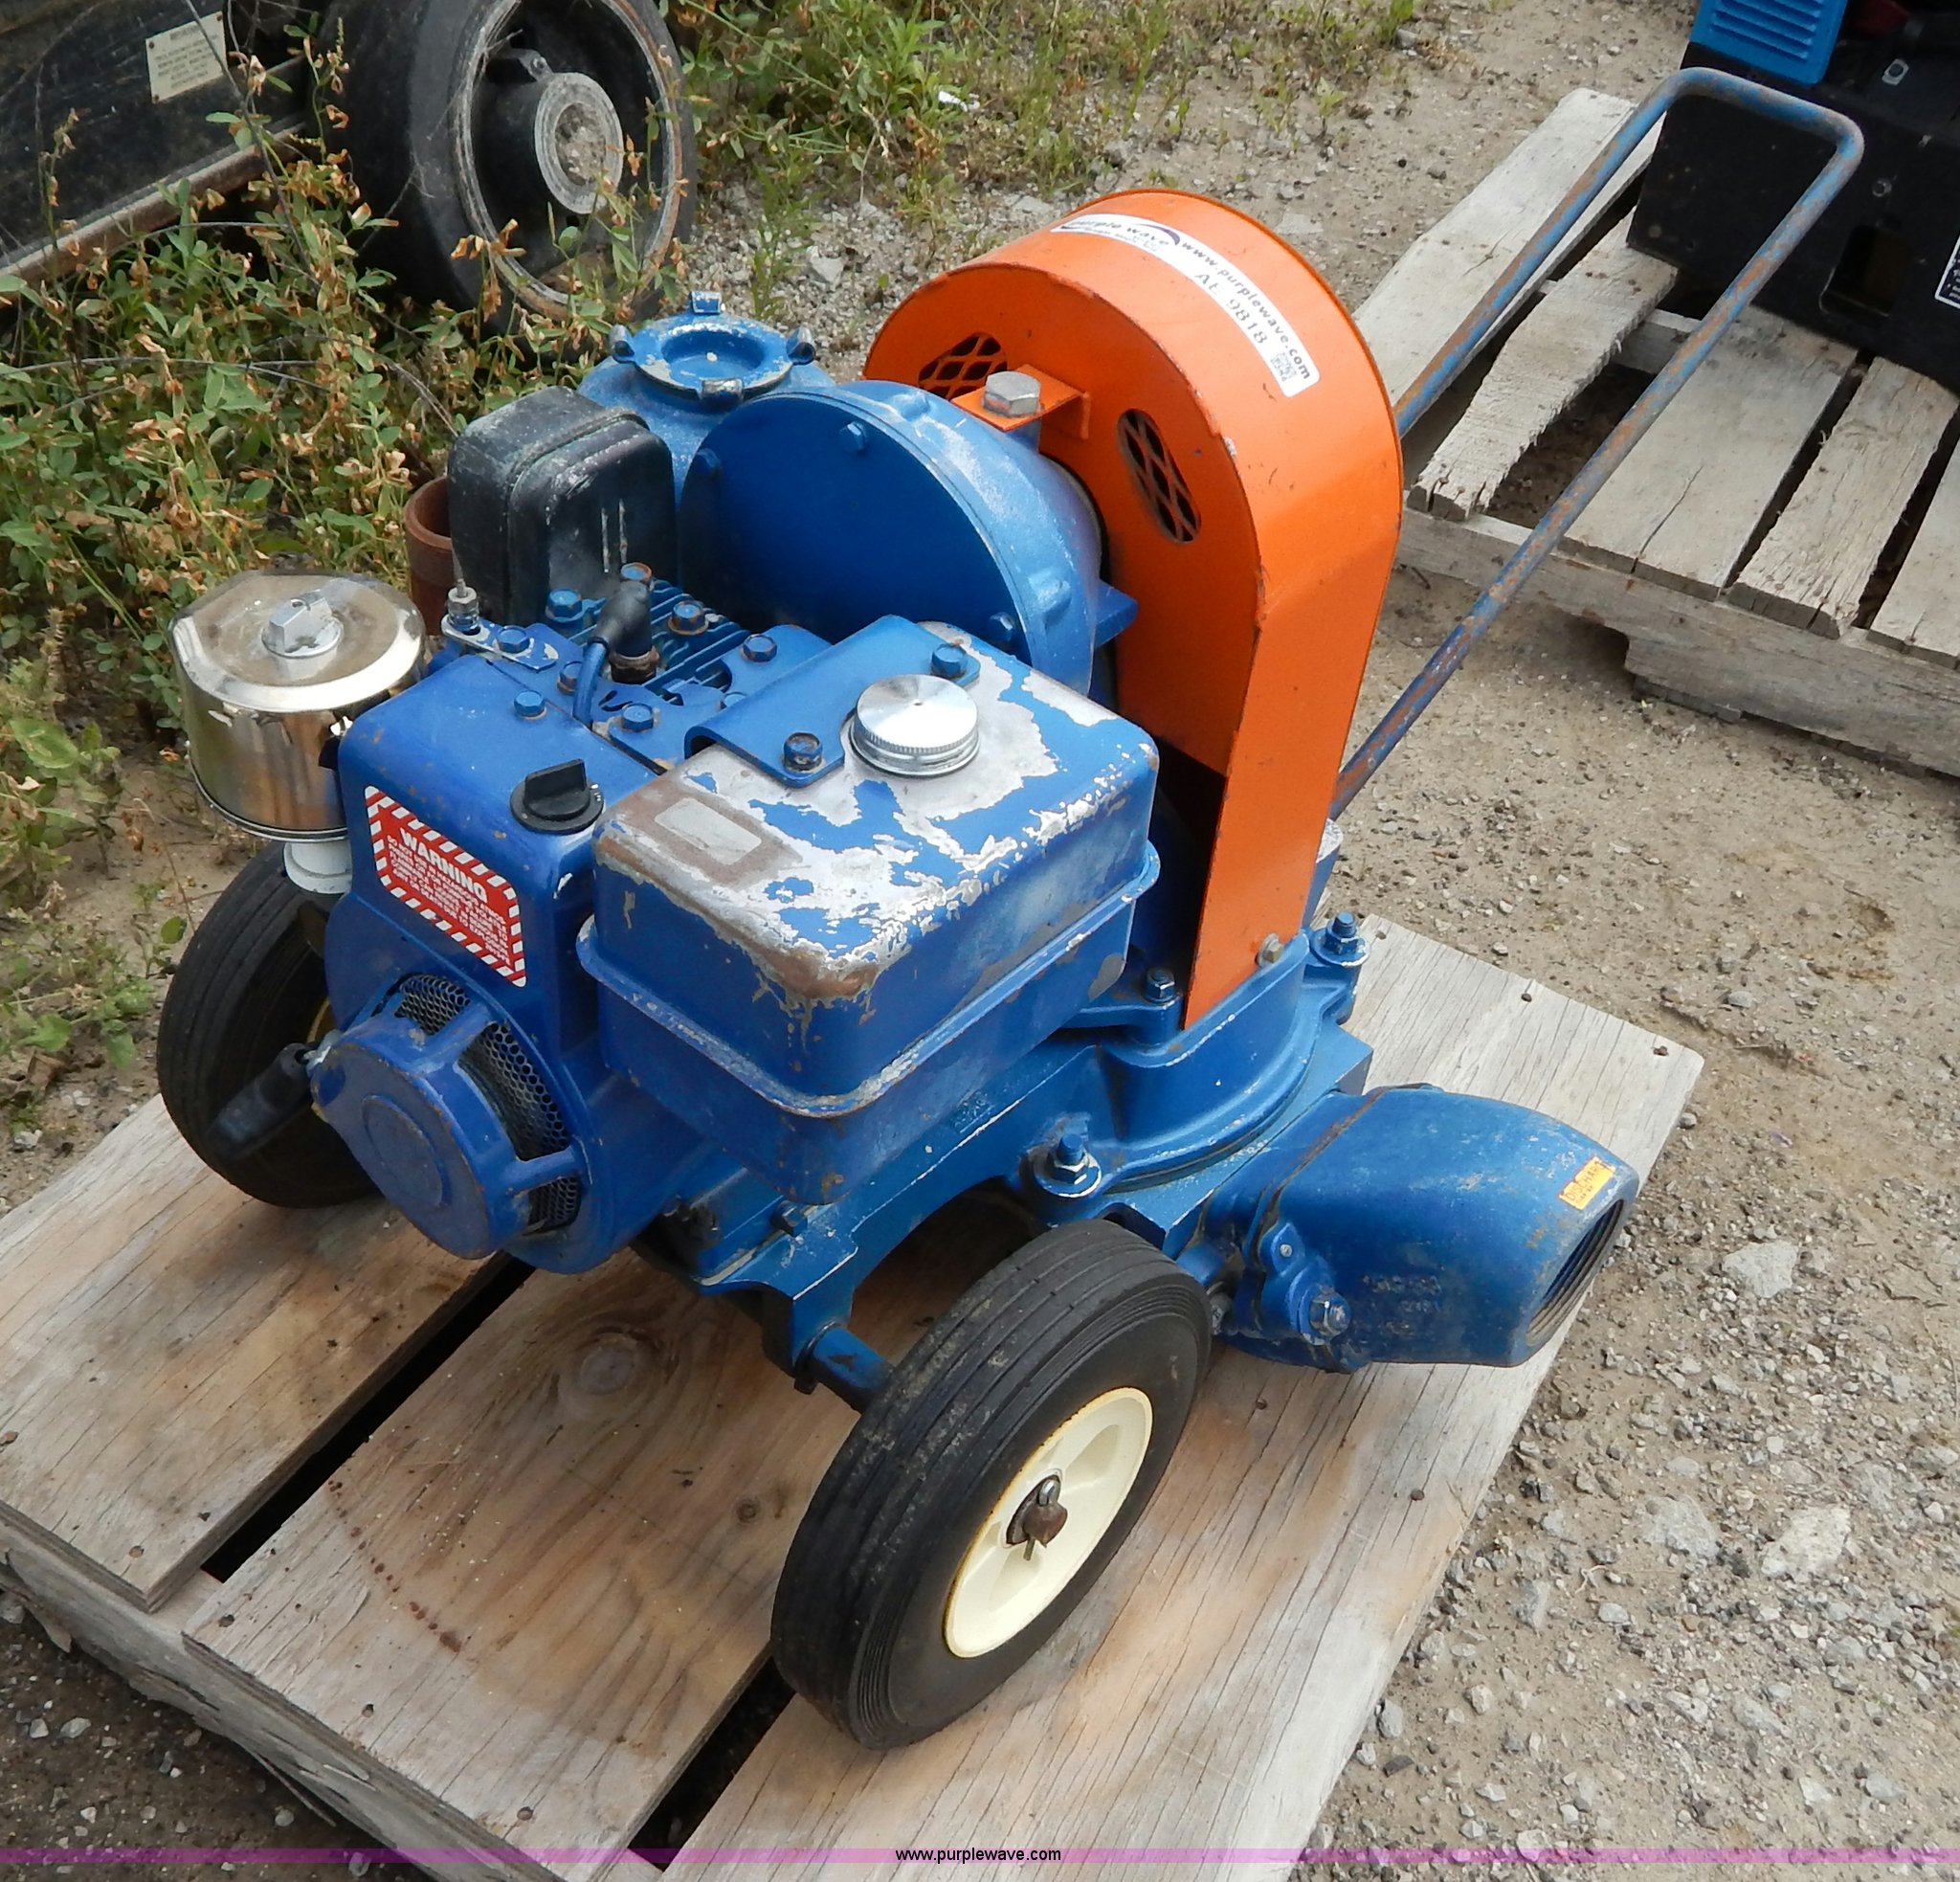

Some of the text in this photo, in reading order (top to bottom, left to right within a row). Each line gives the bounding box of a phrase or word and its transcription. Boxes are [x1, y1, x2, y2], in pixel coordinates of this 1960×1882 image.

[1127, 227, 1169, 245] wave
[1182, 242, 1310, 379] www.purplewave.com
[1228, 299, 1267, 344] 9818
[399, 827, 488, 904] WARNING
